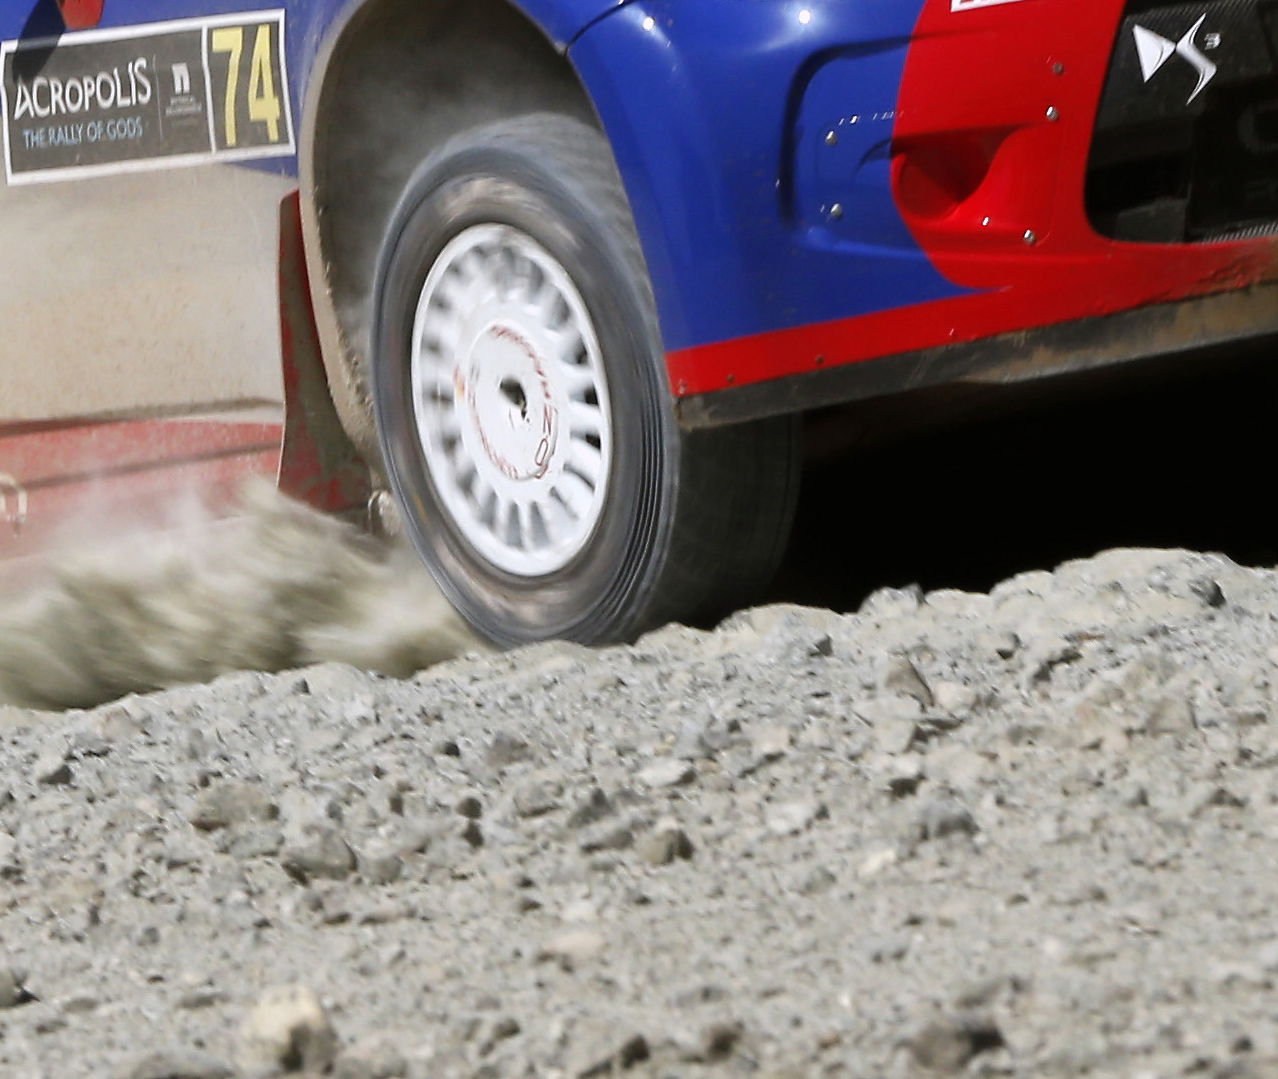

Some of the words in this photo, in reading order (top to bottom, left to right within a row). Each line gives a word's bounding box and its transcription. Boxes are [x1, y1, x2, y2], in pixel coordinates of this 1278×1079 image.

[13, 56, 152, 120] ACROPOLIS
[212, 24, 282, 148] 74
[23, 124, 48, 151] THE
[48, 123, 84, 146] RALLY
[86, 120, 103, 143] OF
[106, 116, 144, 142] GODS
